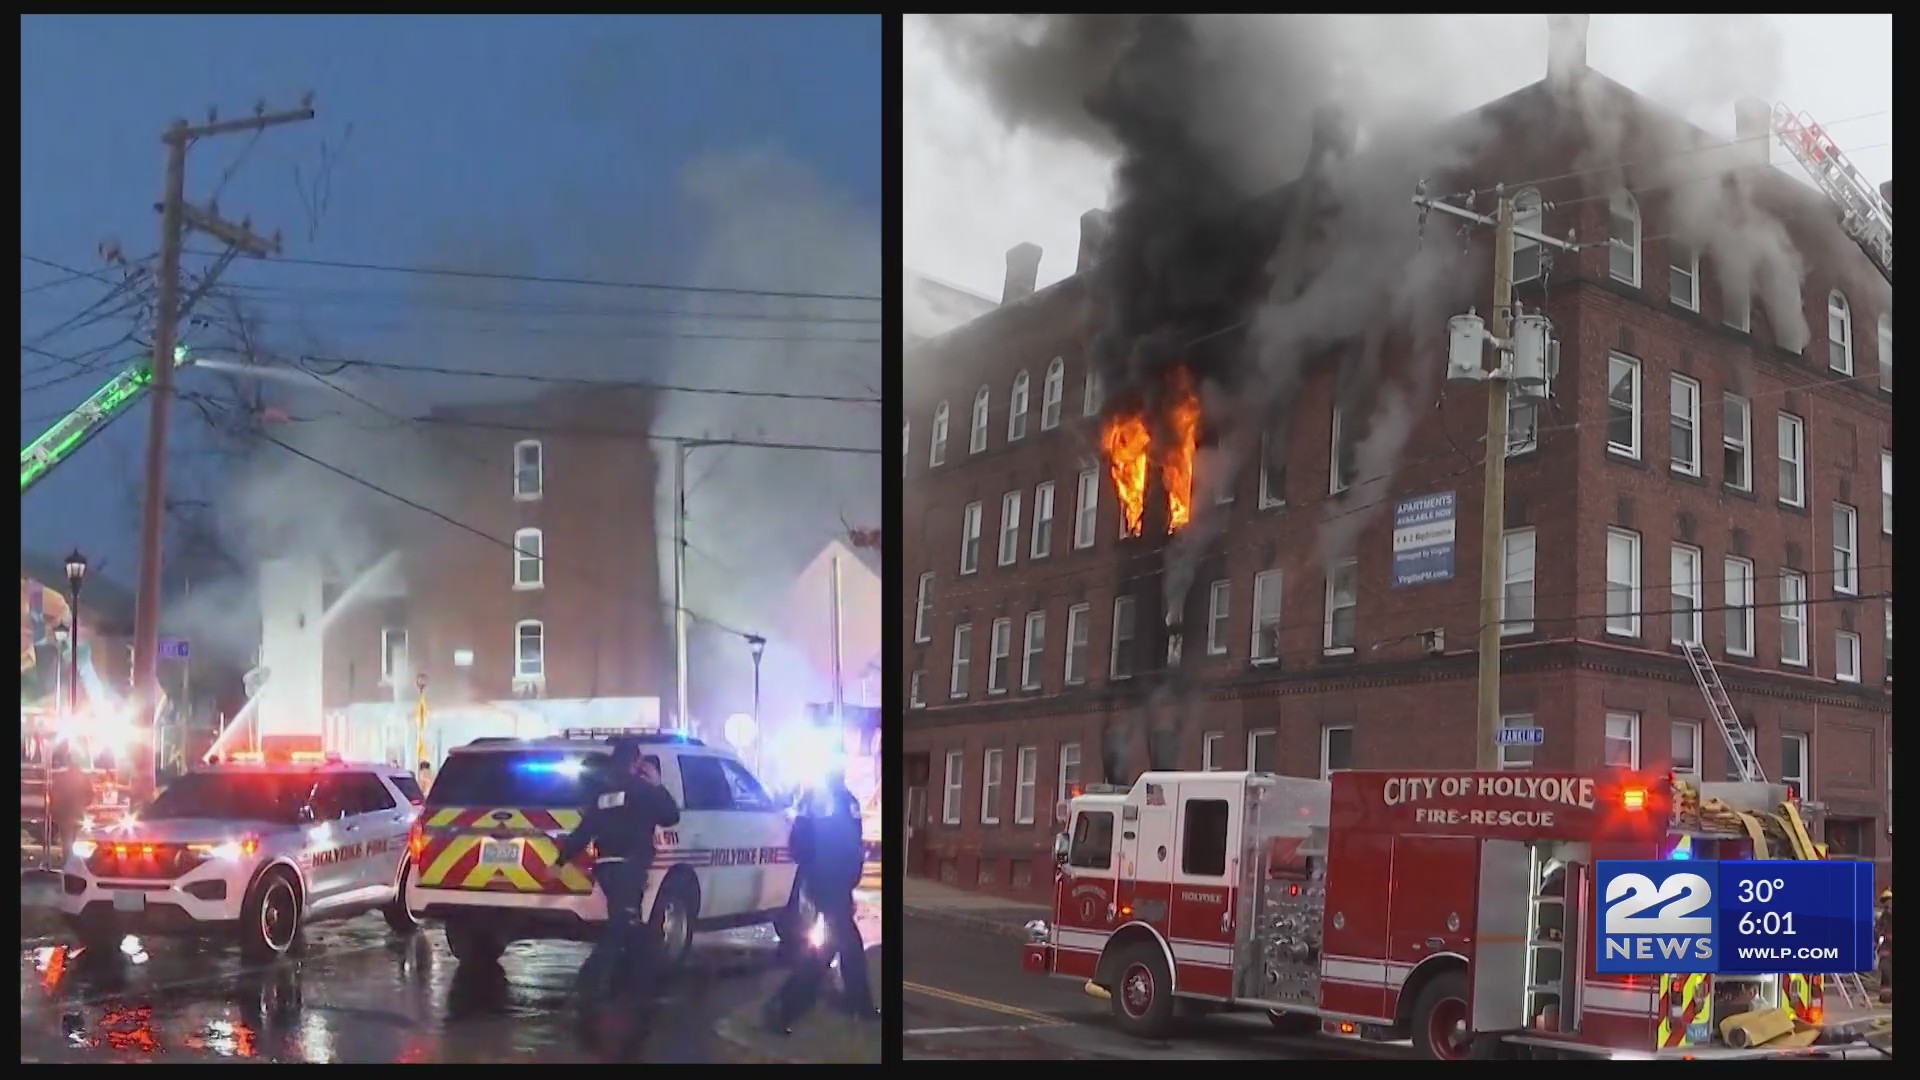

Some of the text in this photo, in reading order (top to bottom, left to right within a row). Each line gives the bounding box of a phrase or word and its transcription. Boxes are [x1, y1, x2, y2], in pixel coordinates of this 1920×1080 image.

[1397, 495, 1453, 514] APARTMENTS
[1397, 507, 1453, 525] AVAILABLE NOW
[1496, 729, 1535, 742] FRANKLIN
[1384, 776, 1597, 810] CITY OF HOLYOKE
[1415, 808, 1554, 827] FIRE-RESCUE
[663, 831, 679, 846] 911
[312, 838, 387, 868] HOLYOKE FIRE
[709, 847, 778, 866] HOLYOKE FIRE
[1181, 891, 1223, 904] HOLYOKE
